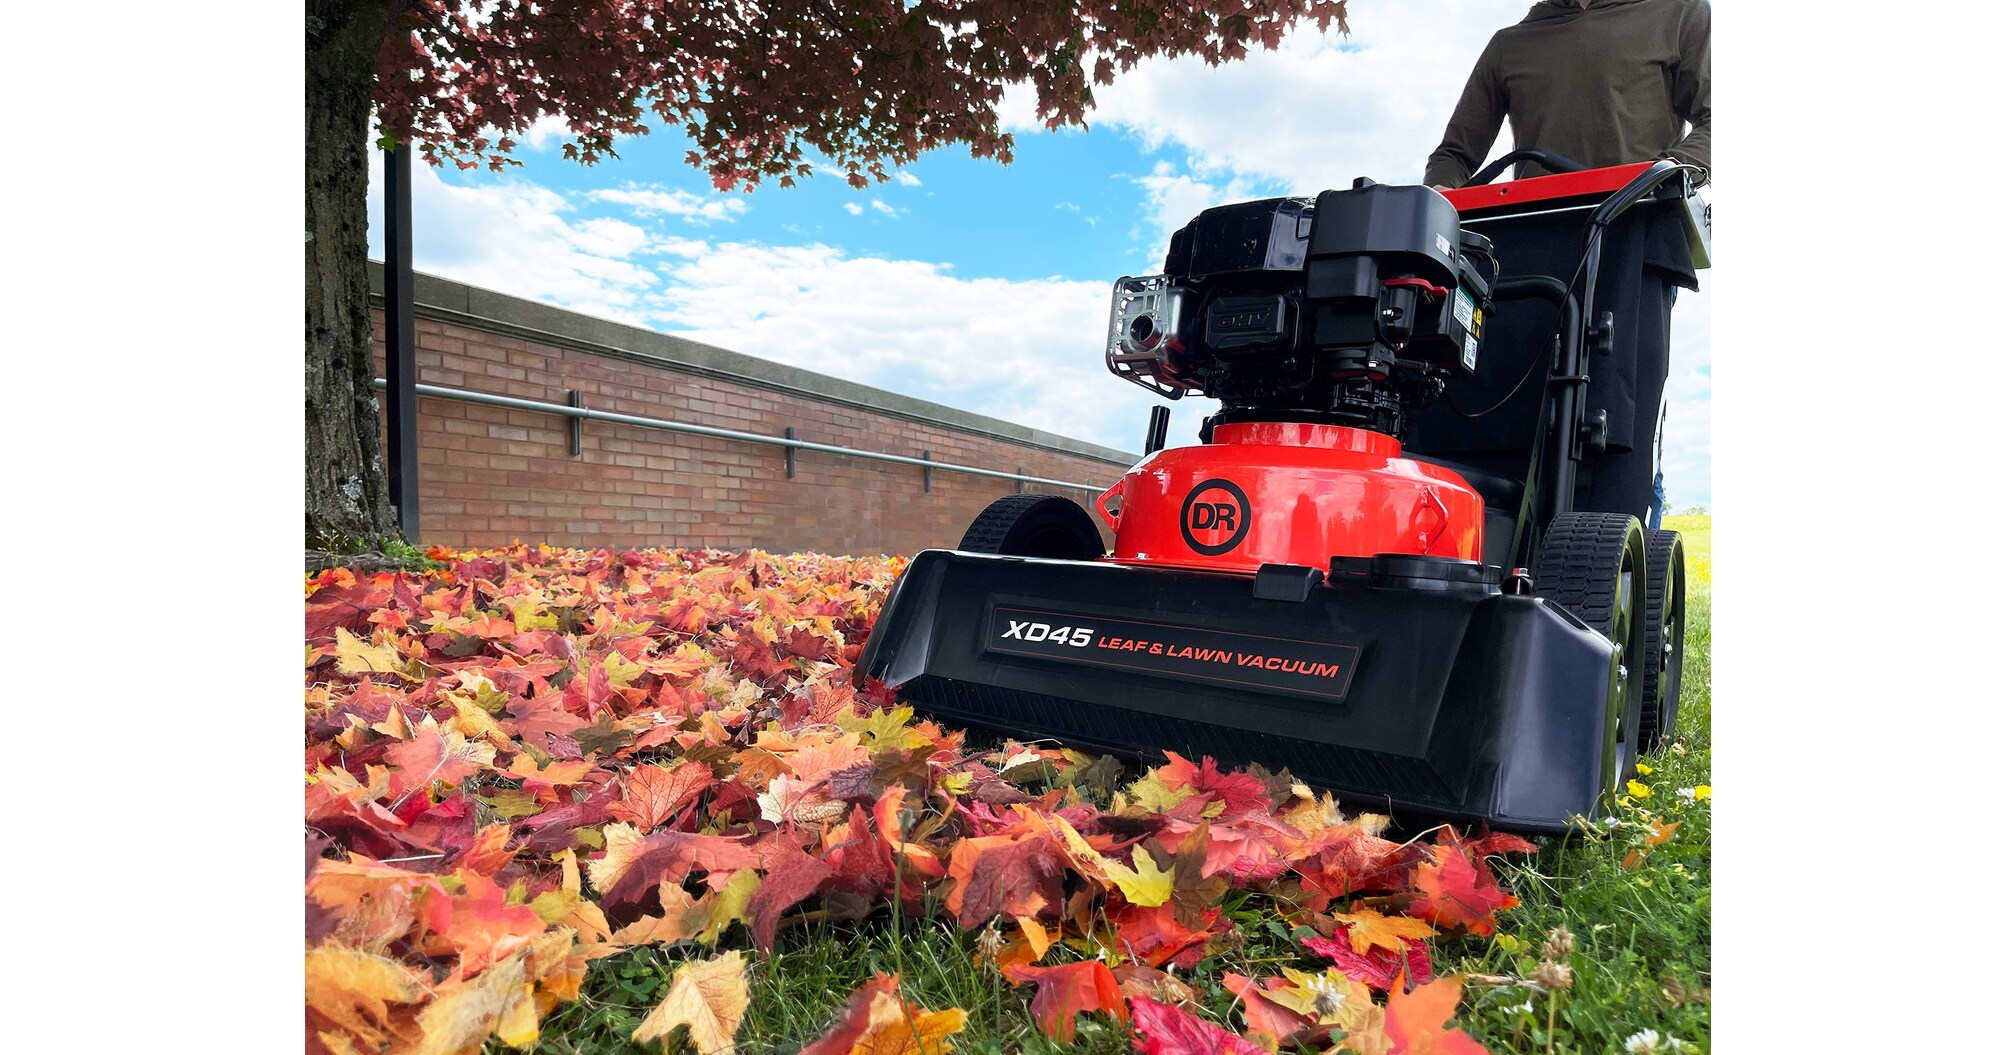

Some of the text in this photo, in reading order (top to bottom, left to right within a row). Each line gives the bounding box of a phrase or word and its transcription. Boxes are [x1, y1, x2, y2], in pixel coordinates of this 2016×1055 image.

[1192, 503, 1236, 530] DR
[1001, 620, 1340, 678] XD45 LEAF & LAWN VACUUM
